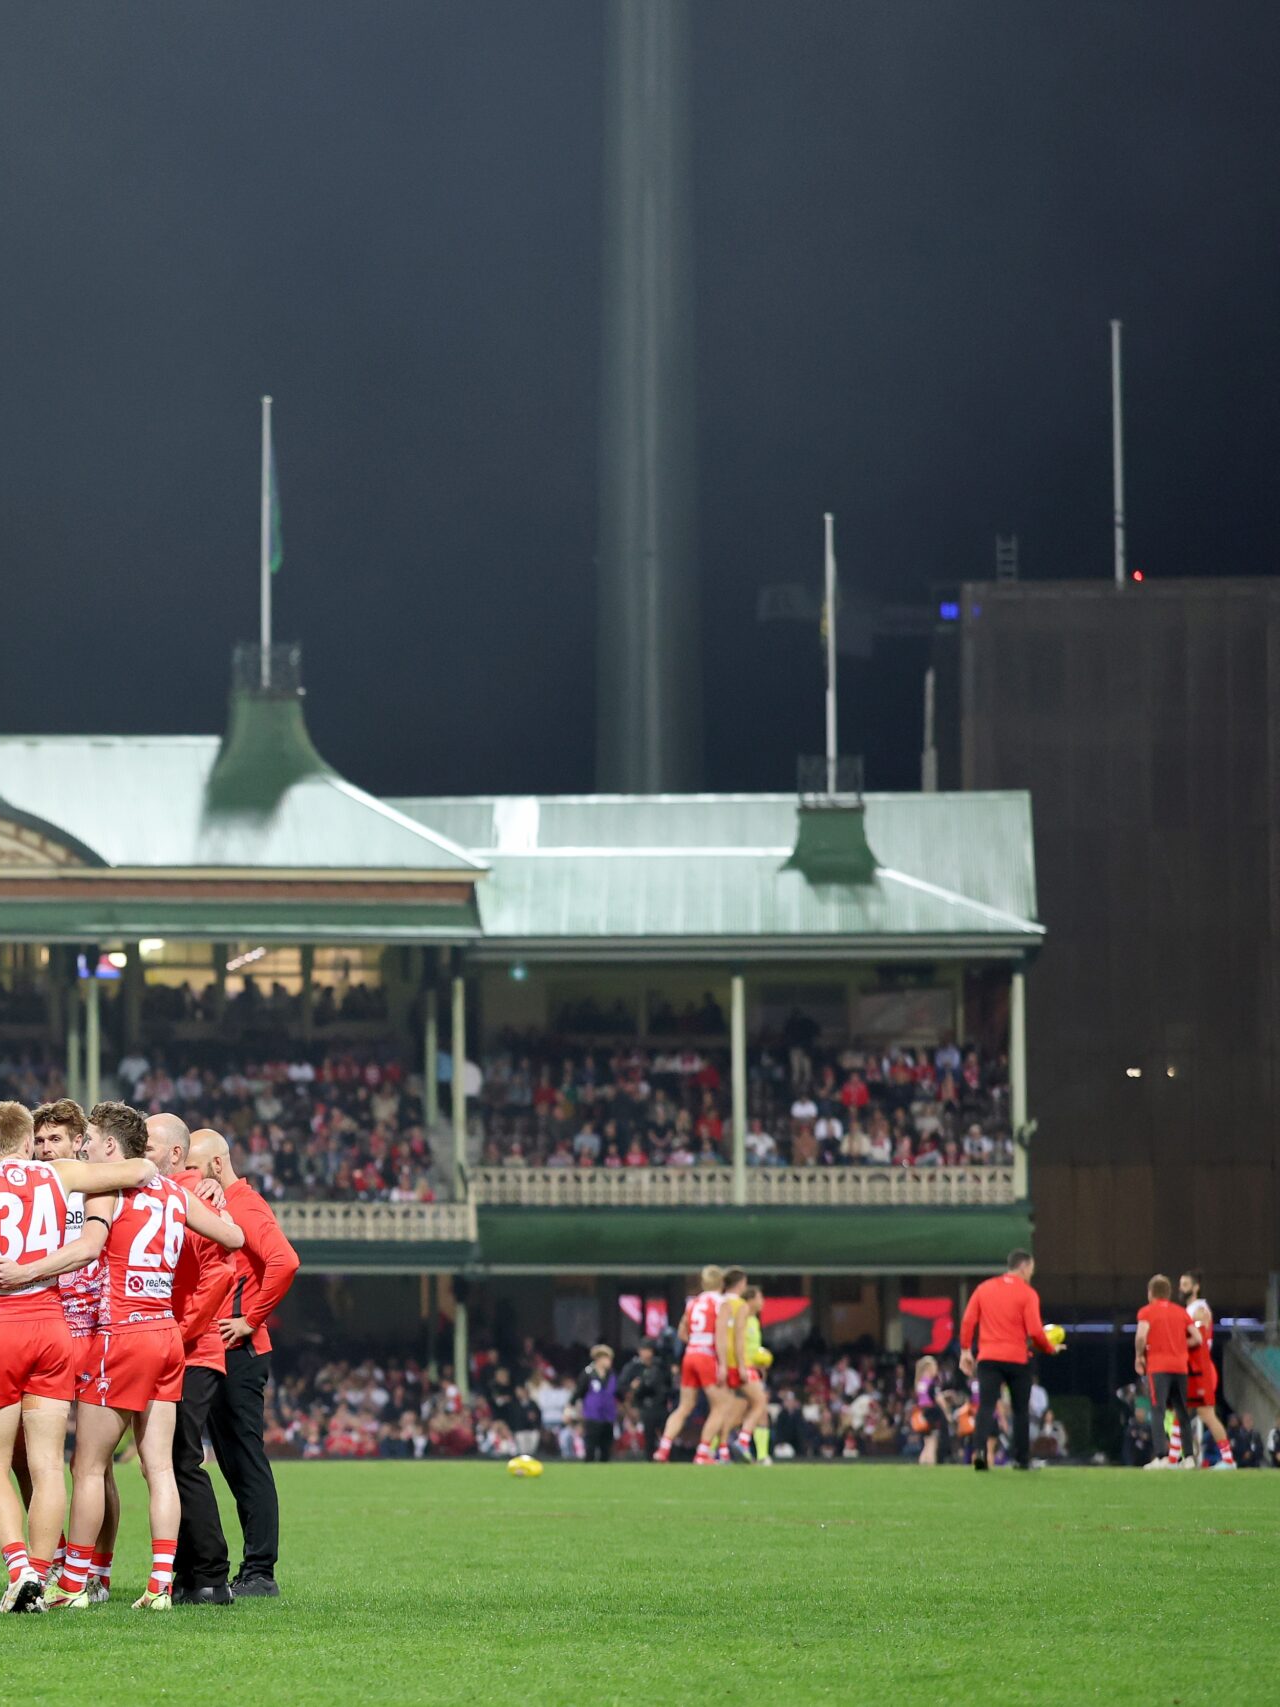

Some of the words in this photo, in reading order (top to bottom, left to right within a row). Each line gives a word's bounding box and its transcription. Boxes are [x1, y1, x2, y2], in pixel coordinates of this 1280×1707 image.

[65, 1211, 84, 1224] QB
[128, 1192, 186, 1269] 26
[690, 1303, 708, 1332] 5
